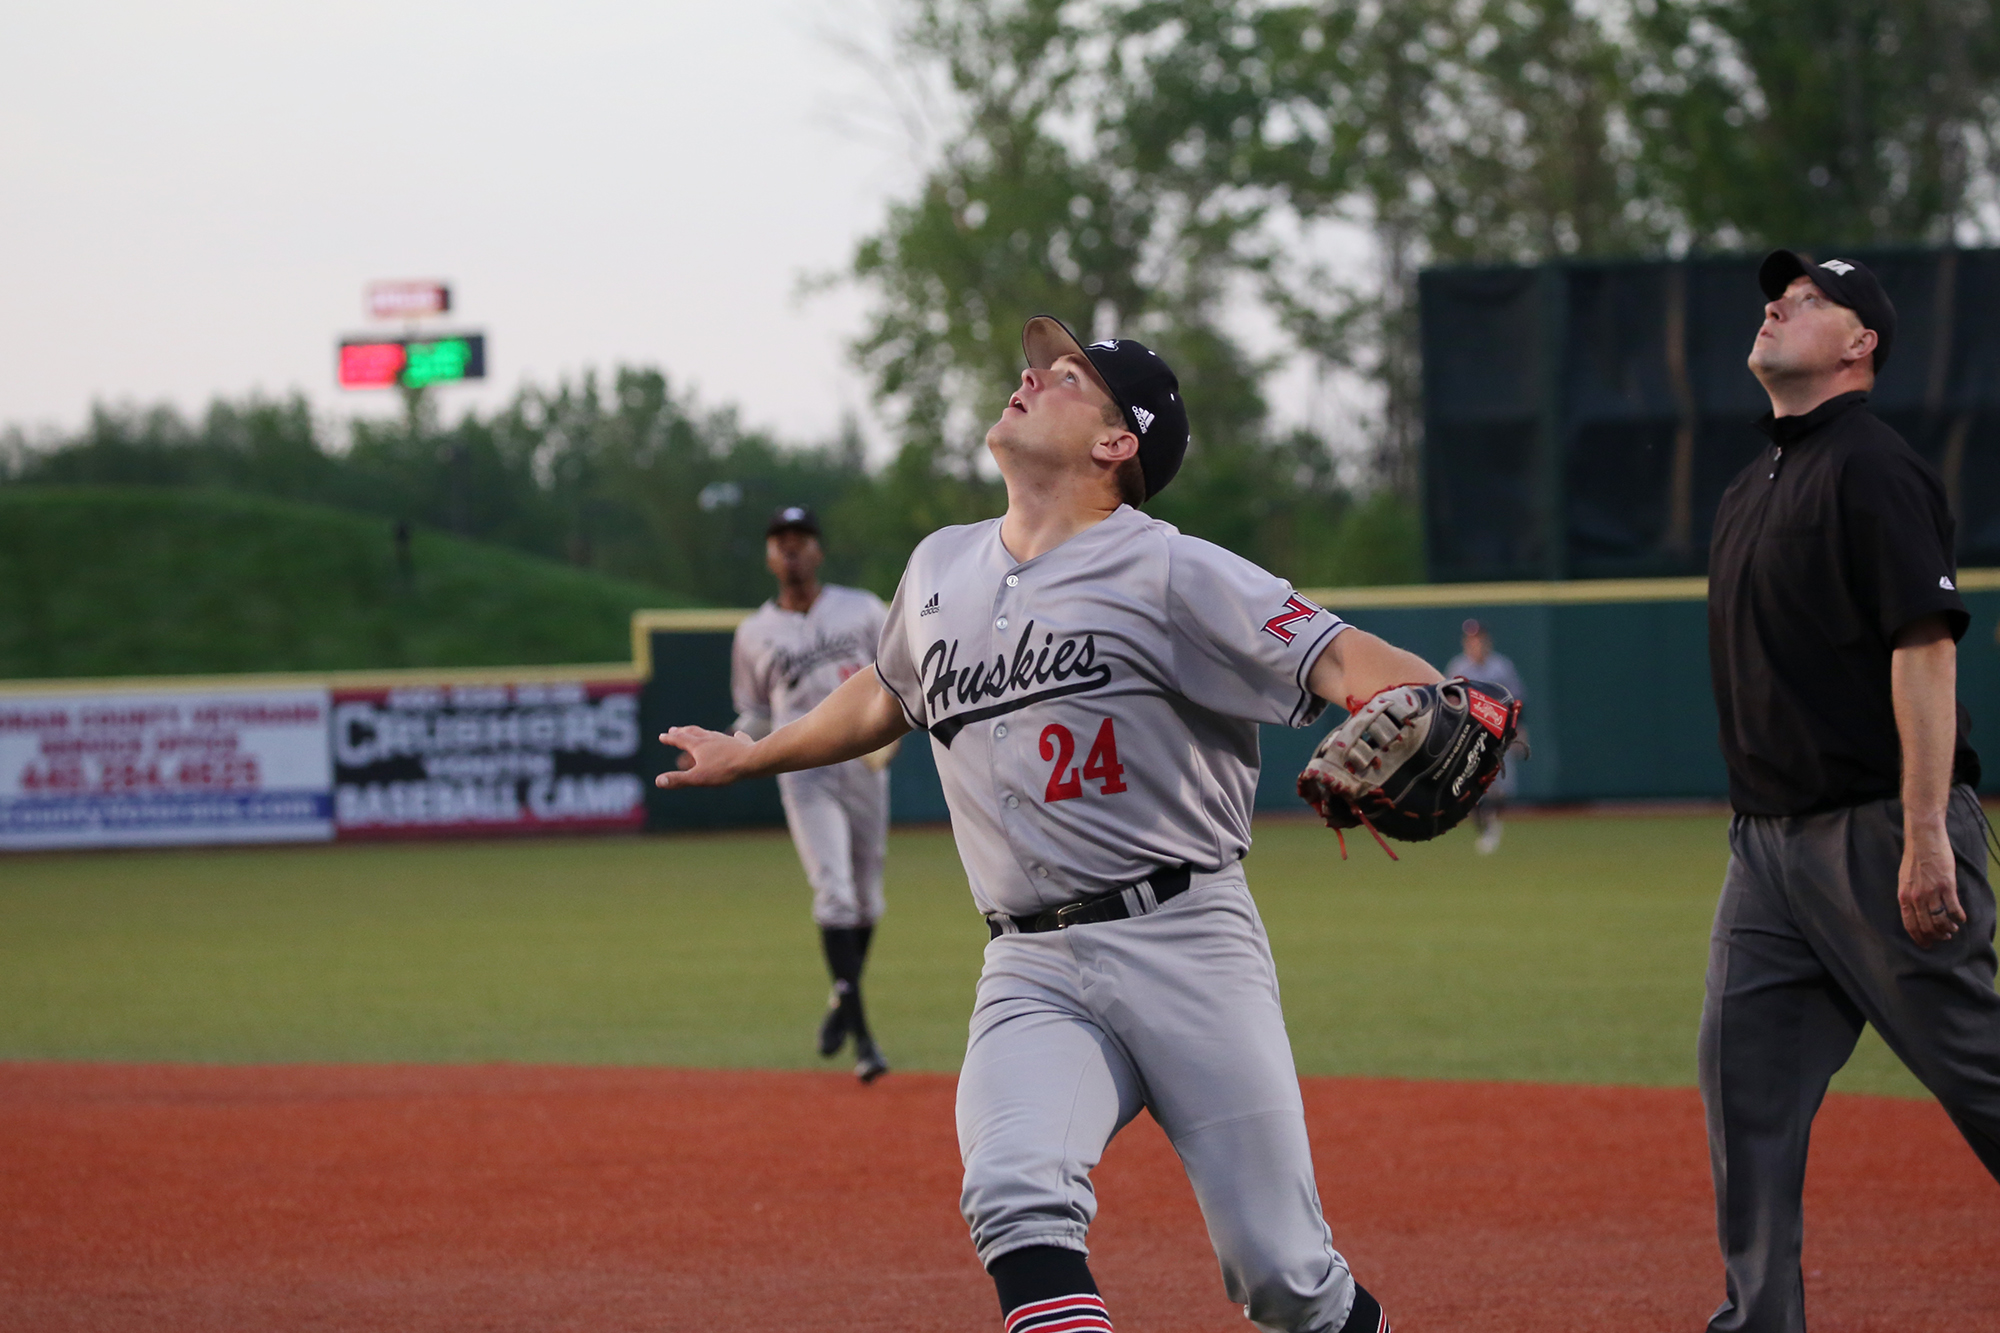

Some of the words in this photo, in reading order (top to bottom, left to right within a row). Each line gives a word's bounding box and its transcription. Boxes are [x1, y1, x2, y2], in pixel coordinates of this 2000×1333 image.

[1131, 405, 1148, 434] adidas
[921, 619, 1104, 719] Huskies
[1038, 717, 1128, 803] 24
